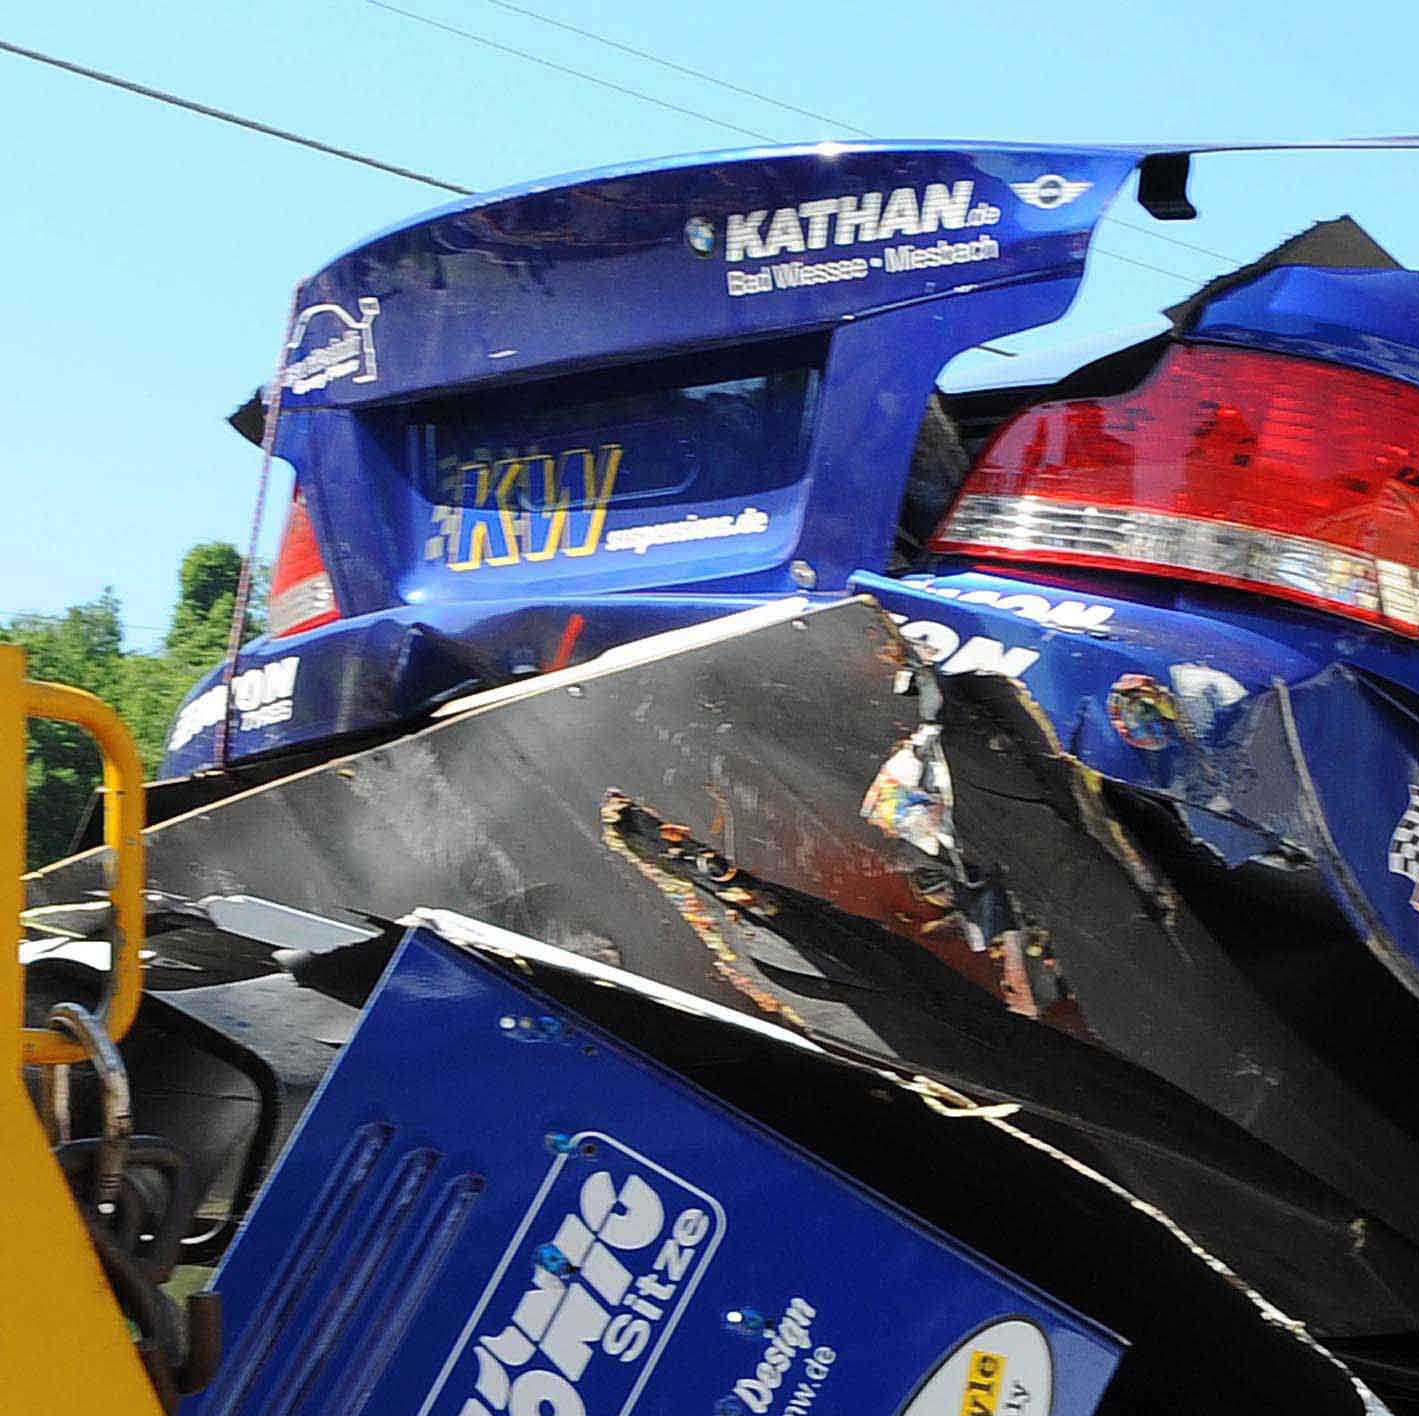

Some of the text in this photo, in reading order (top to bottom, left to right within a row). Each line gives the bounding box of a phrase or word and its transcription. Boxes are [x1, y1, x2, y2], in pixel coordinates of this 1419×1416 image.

[727, 267, 773, 296] Bad
[884, 235, 1000, 273] Miesbach
[446, 443, 624, 572] KW
[601, 1207, 710, 1363] Sitze
[731, 1296, 817, 1414] Design
